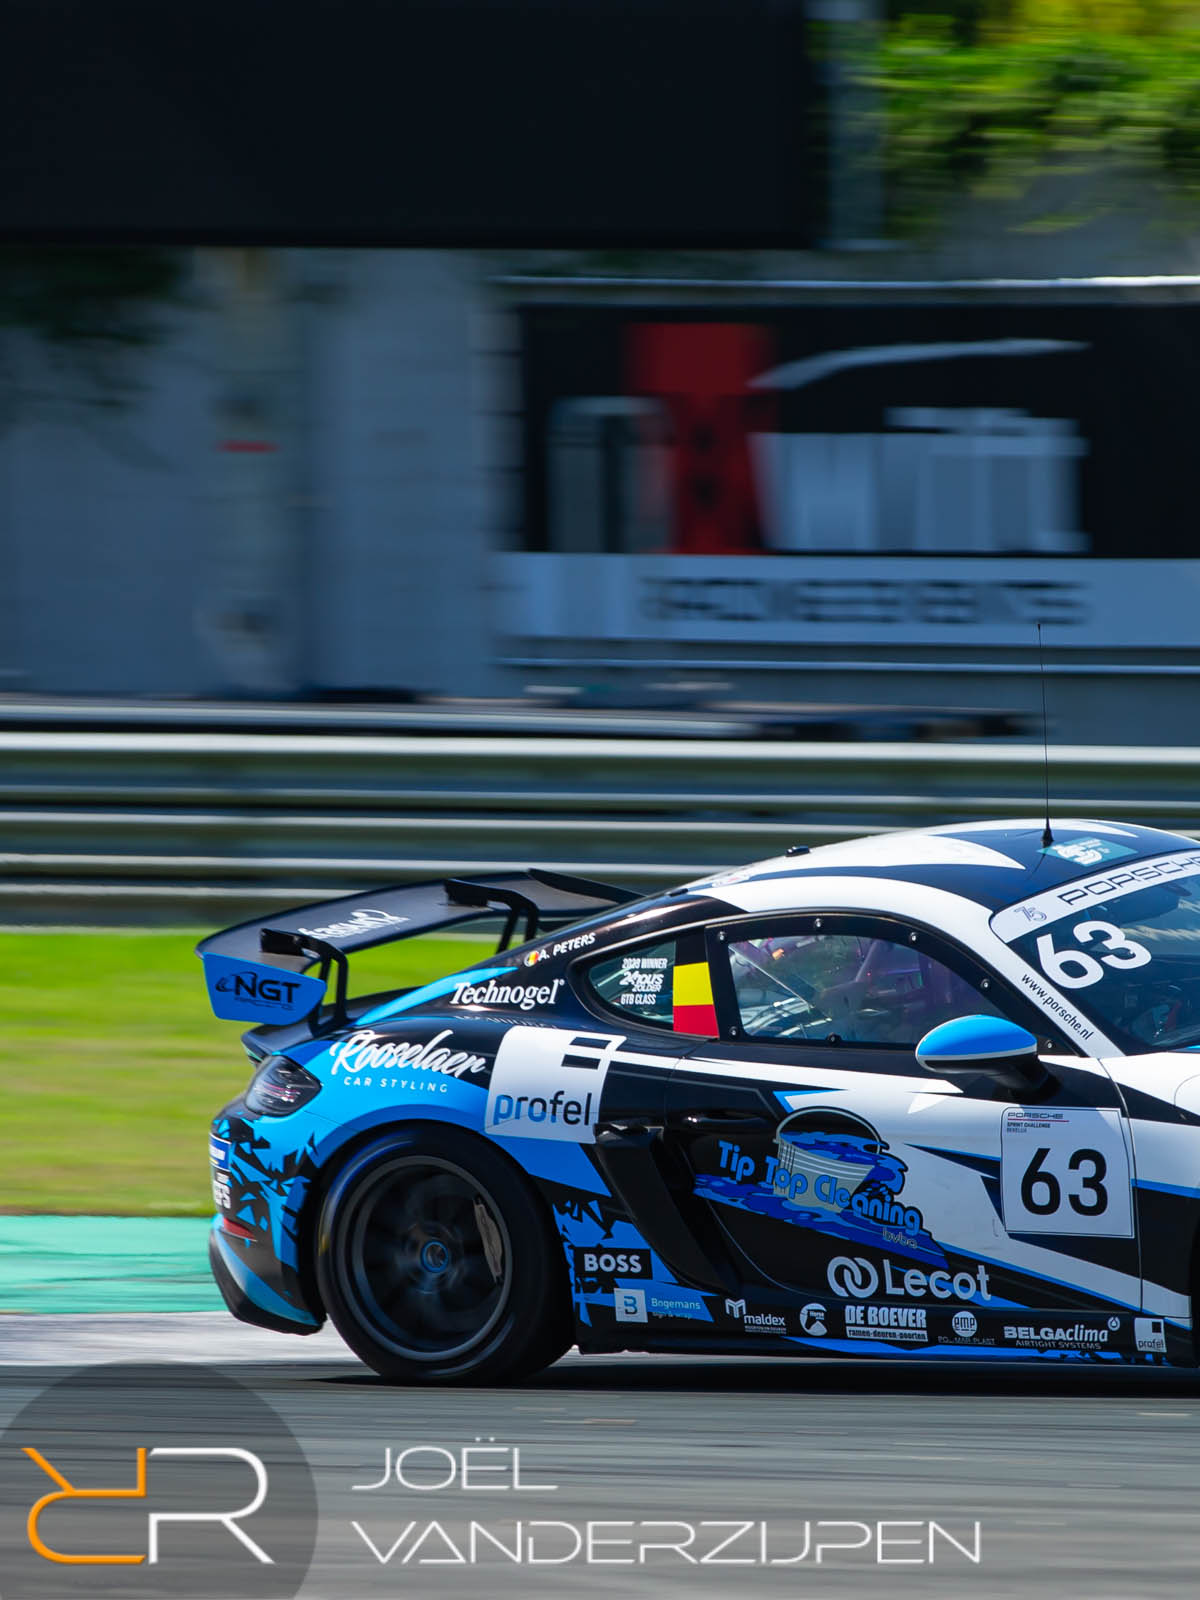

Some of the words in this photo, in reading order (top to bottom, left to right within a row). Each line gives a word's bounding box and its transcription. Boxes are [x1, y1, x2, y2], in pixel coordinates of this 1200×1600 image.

[553, 933, 596, 956] PETERS
[1036, 921, 1152, 989] 63
[635, 994, 656, 1005] CLASS
[1021, 973, 1094, 1040] www.porsche.nl
[329, 1029, 487, 1078] Rooselaer
[344, 1077, 371, 1087] CAR
[380, 1078, 448, 1093] STYLING
[493, 1091, 592, 1126] profel
[719, 1140, 755, 1182] Tip
[765, 1156, 808, 1199] Top
[814, 1175, 921, 1236] Cleaning
[1021, 1147, 1109, 1217] 63
[584, 1254, 642, 1273] BOSS
[884, 1259, 991, 1300] Lecot
[651, 1298, 701, 1311] Bogemans
[744, 1314, 786, 1326] maldex
[845, 1305, 865, 1325] DE
[867, 1306, 927, 1329] BOEVER
[1003, 1324, 1109, 1342] BELGAclima
[1016, 1339, 1052, 1348] AIRTIGHT
[1055, 1341, 1101, 1350] SYSTEMS
[1138, 1338, 1166, 1350] profel
